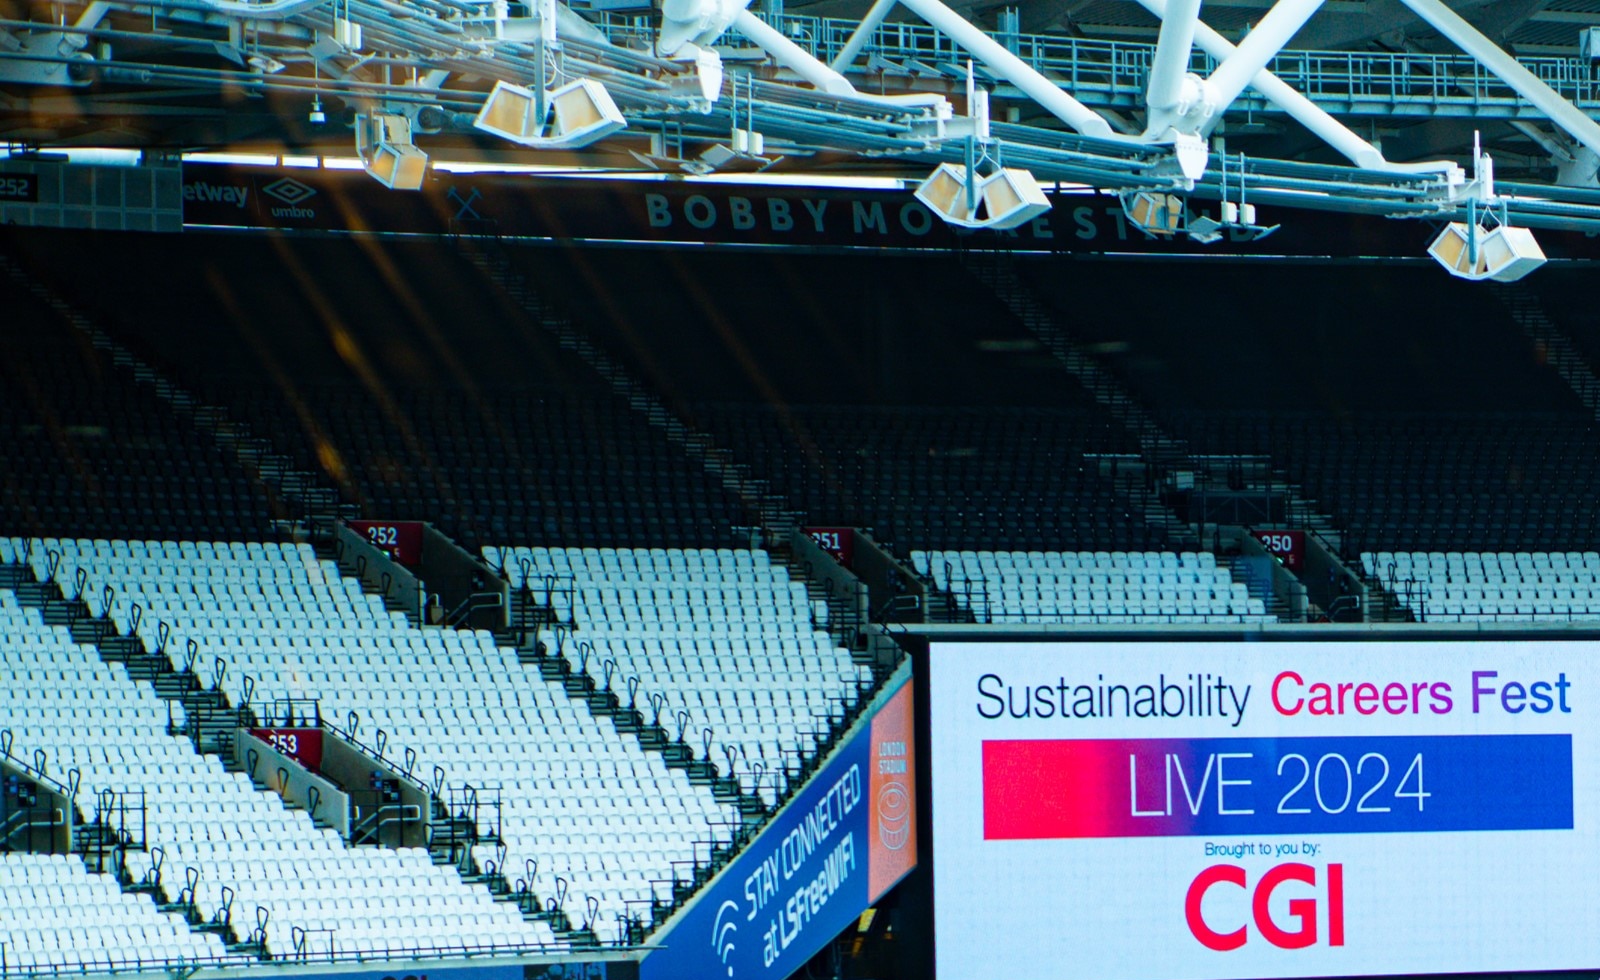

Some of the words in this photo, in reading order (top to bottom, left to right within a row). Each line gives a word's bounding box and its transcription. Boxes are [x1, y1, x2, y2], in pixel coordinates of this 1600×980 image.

[183, 182, 249, 208] etway
[271, 205, 315, 219] umbro
[645, 193, 828, 233] BOBBY
[852, 201, 1055, 239] MOE
[368, 526, 398, 545] 252
[977, 673, 1251, 727] Sustainability
[1271, 670, 1454, 717] Careers
[1472, 670, 1573, 714] Fest
[878, 742, 907, 757] LONDON
[1130, 753, 1255, 817] LIVE
[1277, 752, 1432, 814] 2024
[744, 848, 780, 922] STAY
[781, 763, 861, 881] CONNECTED
[1205, 842, 1255, 859] Brought
[1259, 843, 1272, 855] to
[1275, 843, 1298, 858] you
[1302, 841, 1321, 857] by:
[763, 920, 780, 968] at
[780, 832, 856, 951] LSFreeWIFI
[1185, 863, 1344, 952] CGI
